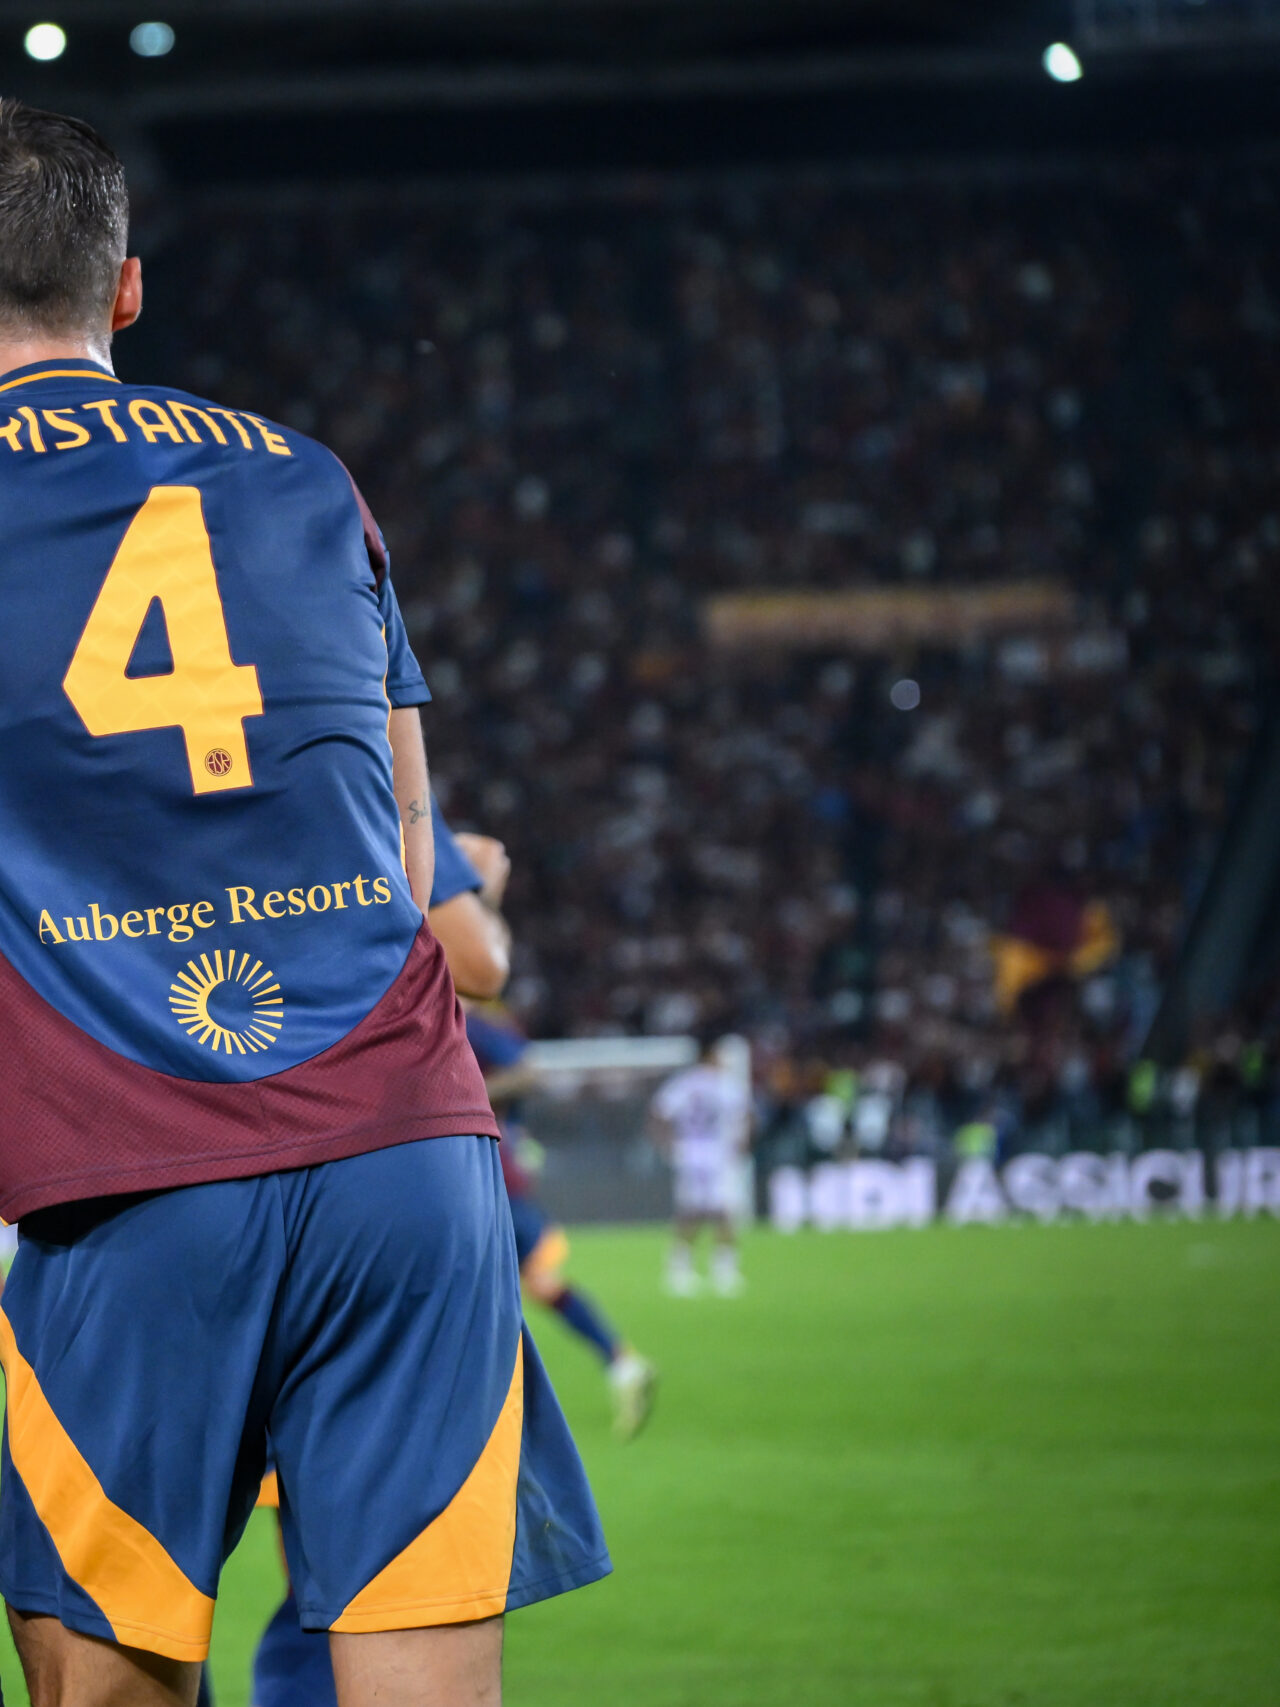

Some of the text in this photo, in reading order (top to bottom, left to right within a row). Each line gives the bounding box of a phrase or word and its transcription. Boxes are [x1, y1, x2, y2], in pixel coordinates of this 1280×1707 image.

[62, 485, 265, 796] 4
[38, 872, 392, 944] Auberge Resorts
